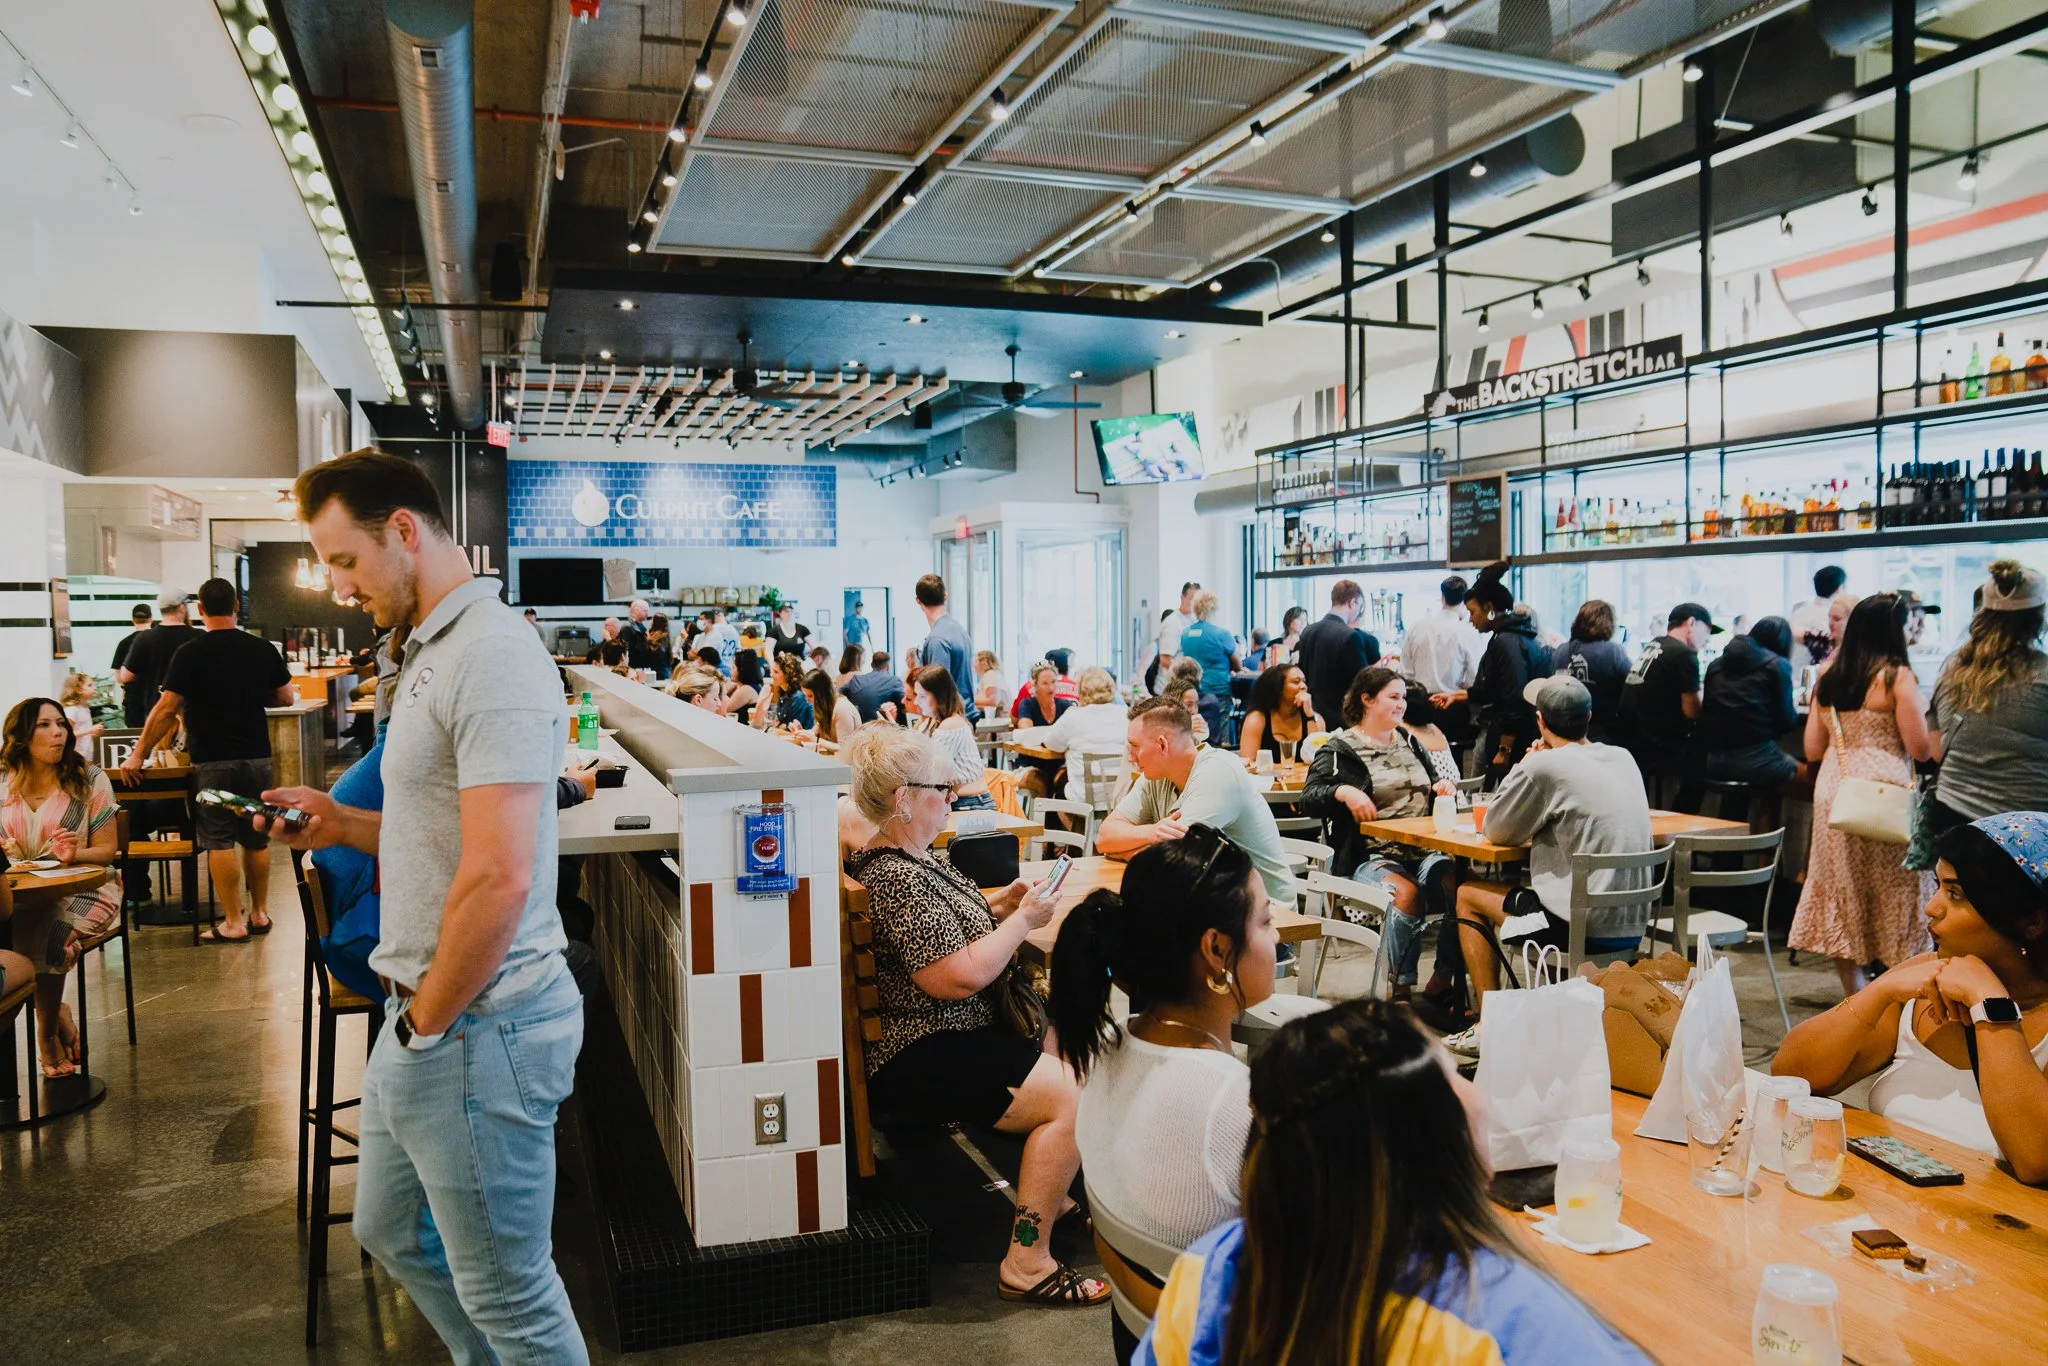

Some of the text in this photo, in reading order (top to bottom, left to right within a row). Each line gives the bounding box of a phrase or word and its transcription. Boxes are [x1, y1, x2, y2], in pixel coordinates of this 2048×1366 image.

[1456, 346, 1676, 413] THE BACKSTRETCH BAR
[615, 493, 712, 520] CULPRIT
[721, 639, 737, 657] 22
[1016, 1204, 1042, 1226] Molly
